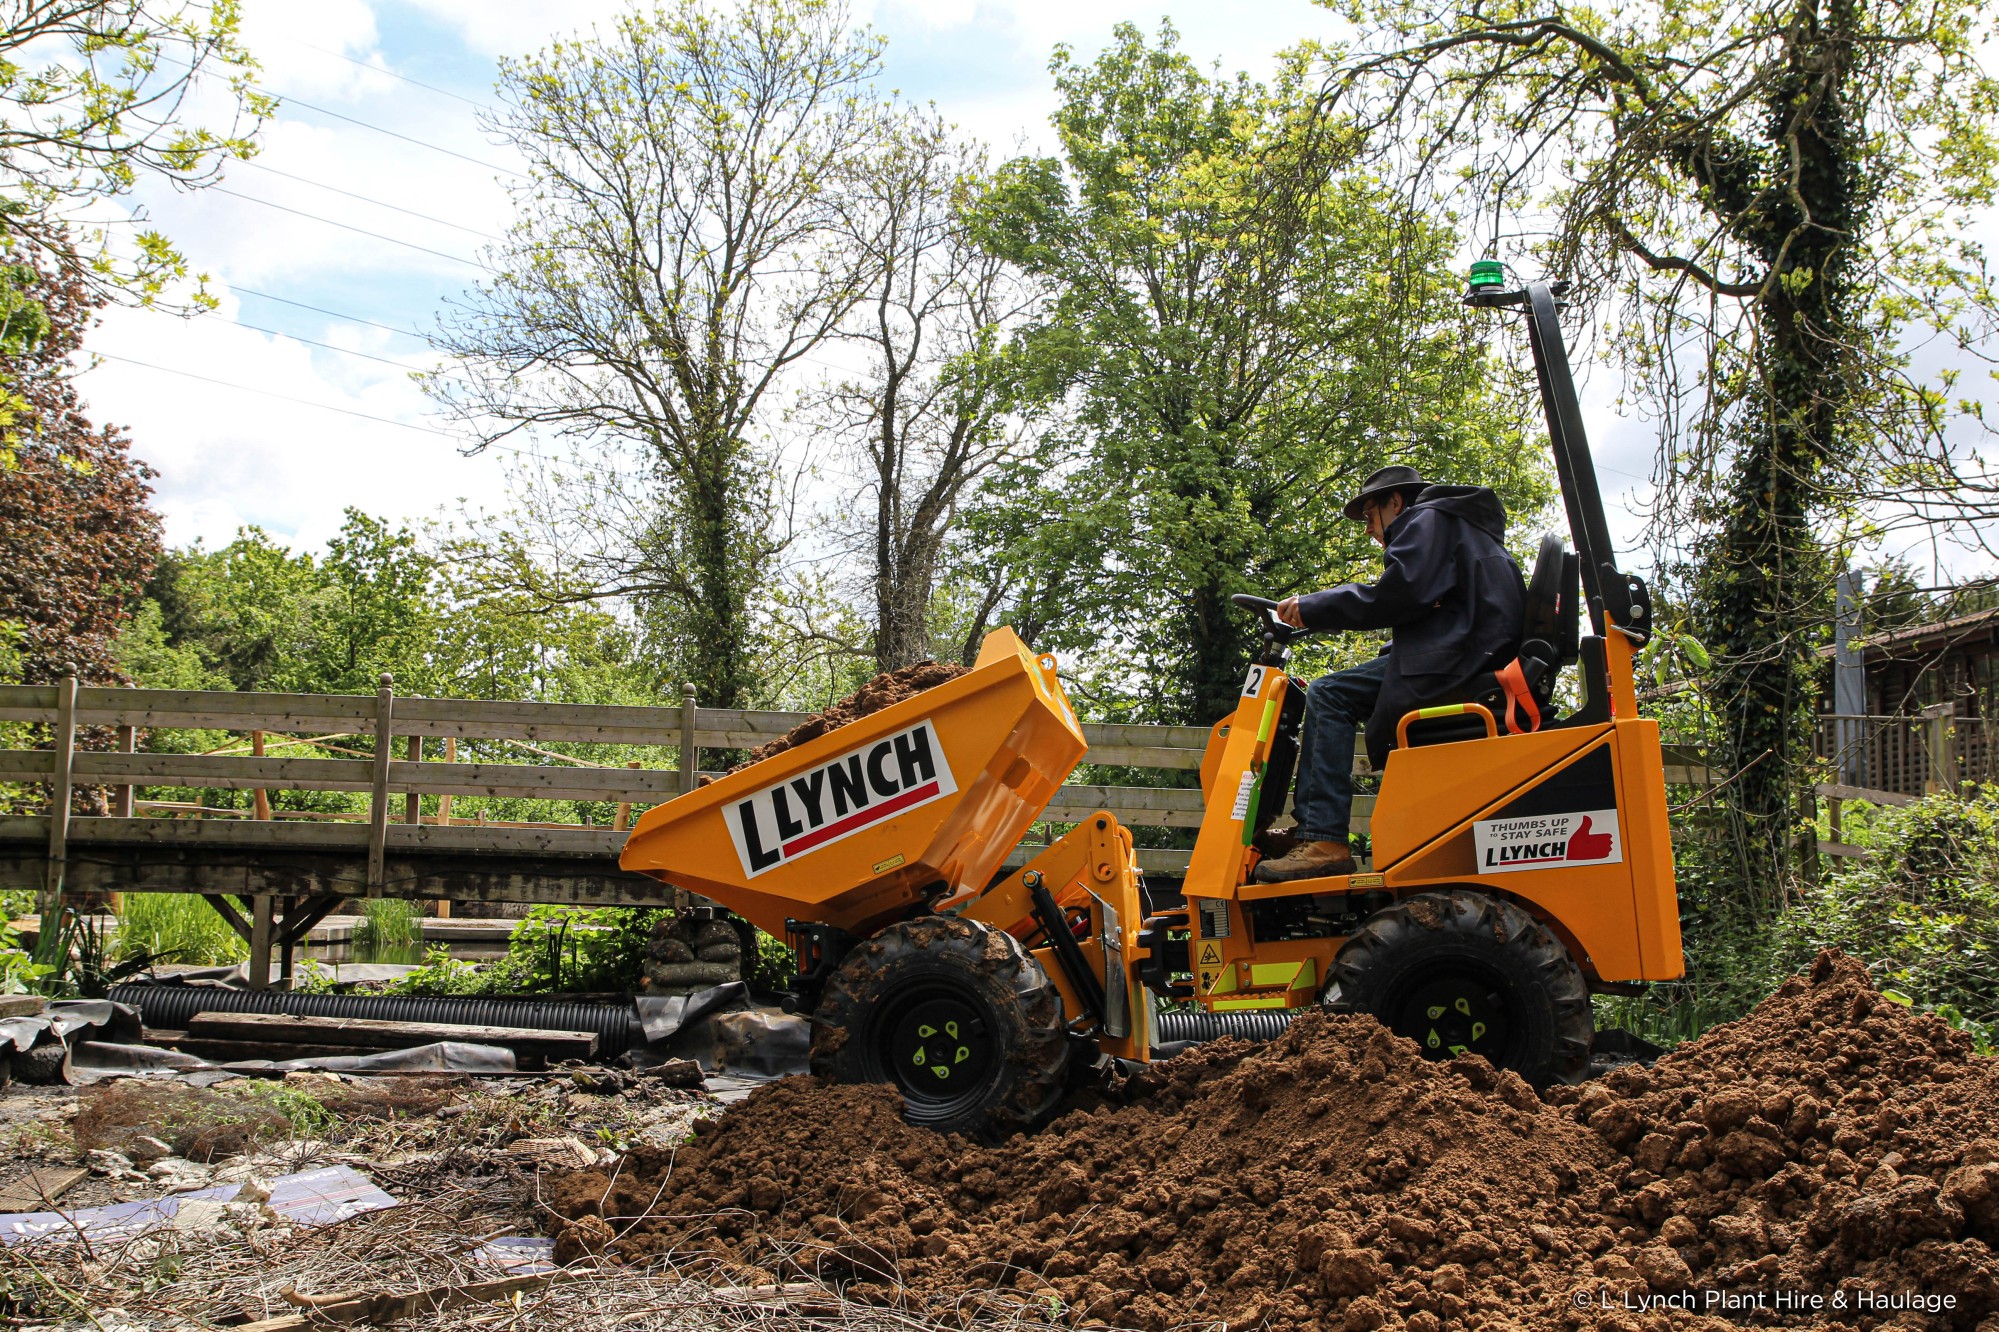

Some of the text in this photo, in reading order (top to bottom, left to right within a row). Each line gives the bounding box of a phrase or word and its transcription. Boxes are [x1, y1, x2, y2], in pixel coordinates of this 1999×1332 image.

[1246, 668, 1261, 695] 2
[739, 726, 937, 873] L LYNCH
[1491, 818, 1570, 832] THUMBS UP
[1500, 830, 1531, 841] STAY
[1535, 828, 1568, 838] SAFE
[1485, 841, 1566, 867] L LYNCH
